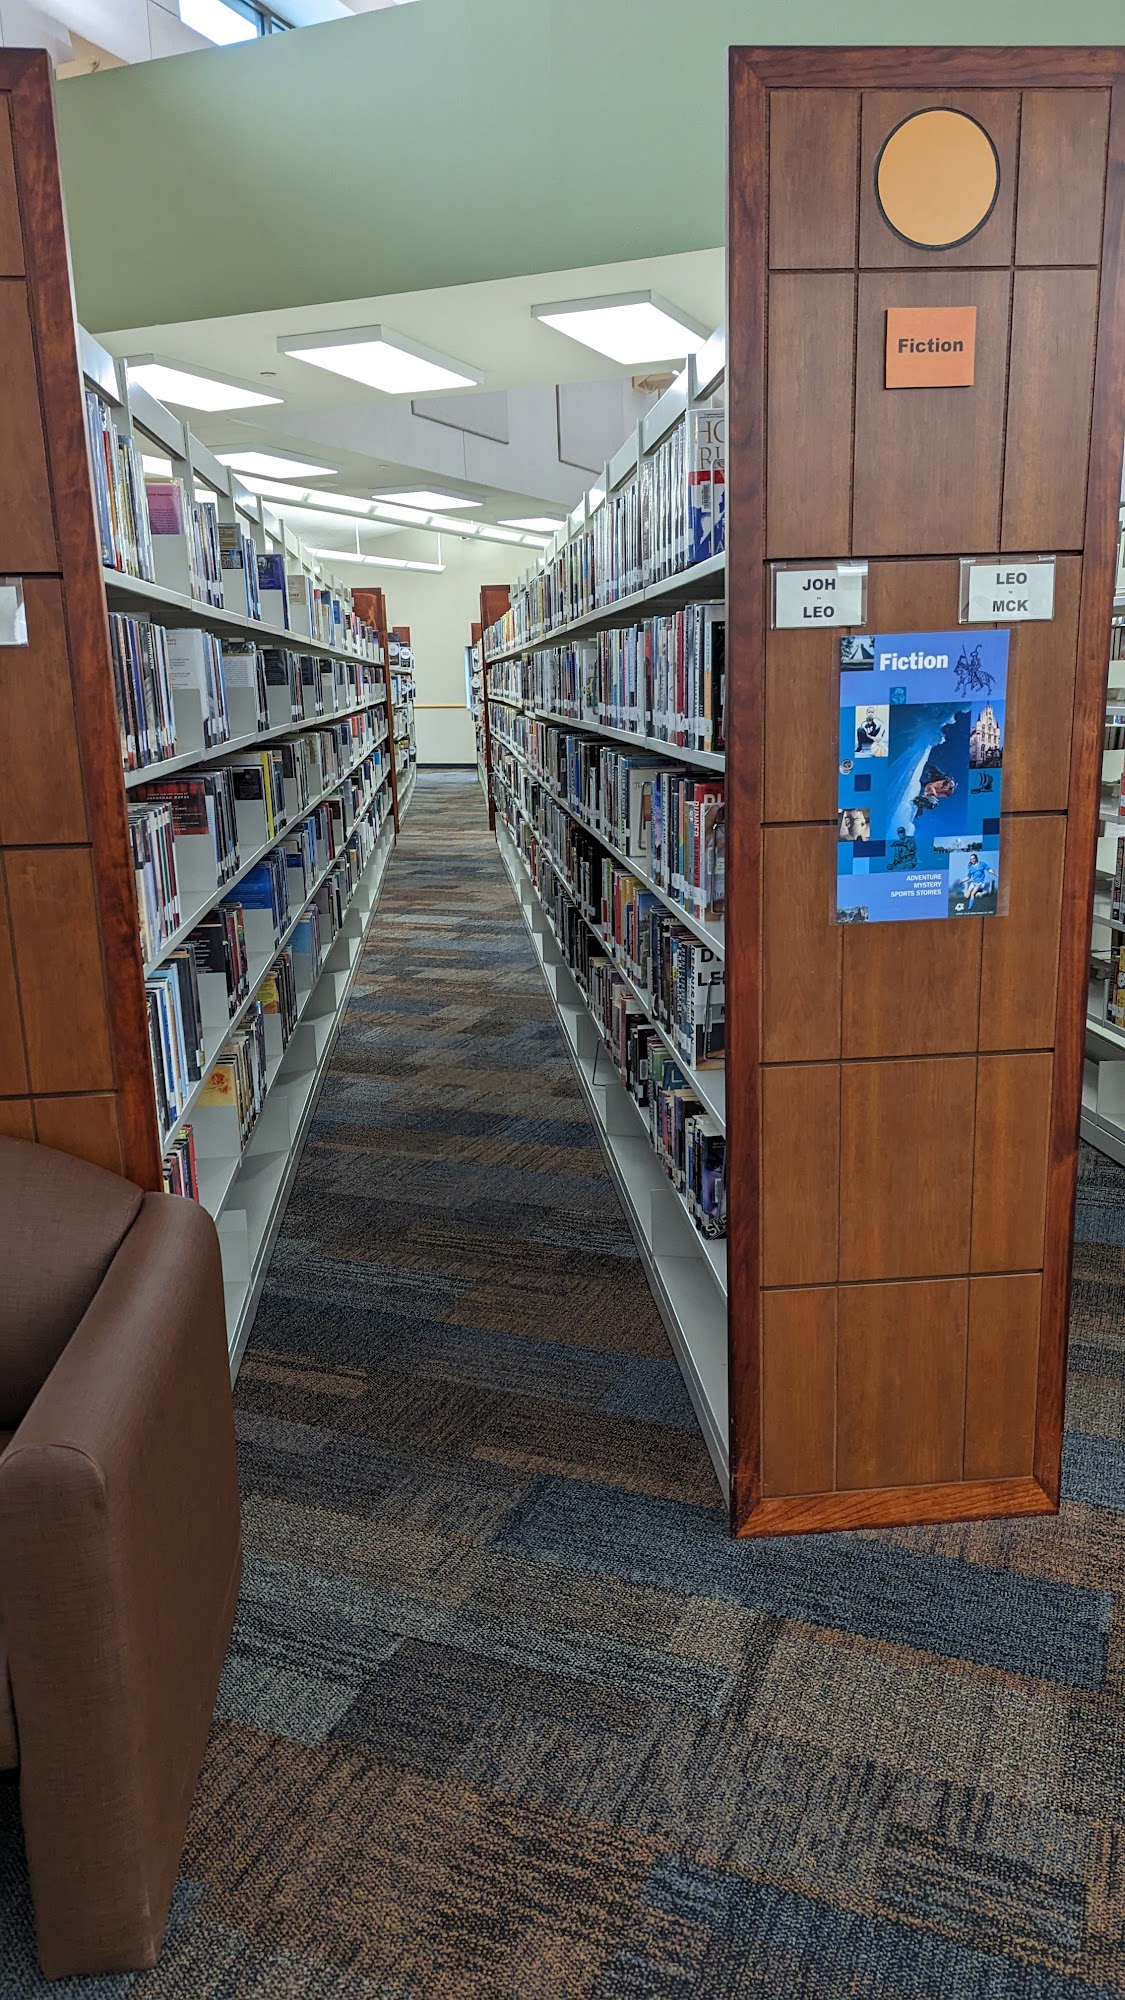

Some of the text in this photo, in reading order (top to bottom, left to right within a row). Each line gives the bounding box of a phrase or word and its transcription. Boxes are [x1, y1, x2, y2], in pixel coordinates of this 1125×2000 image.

[897, 338, 964, 354] Fiction
[802, 578, 836, 591] JOH
[996, 572, 1028, 585] LEO
[803, 606, 835, 618] LEO
[992, 599, 1029, 612] MCK
[879, 653, 949, 671] Fiction
[906, 873, 942, 881] ADVENTURE
[913, 881, 942, 889] MYSTERY
[890, 888, 942, 898] SPORTS STORIES
